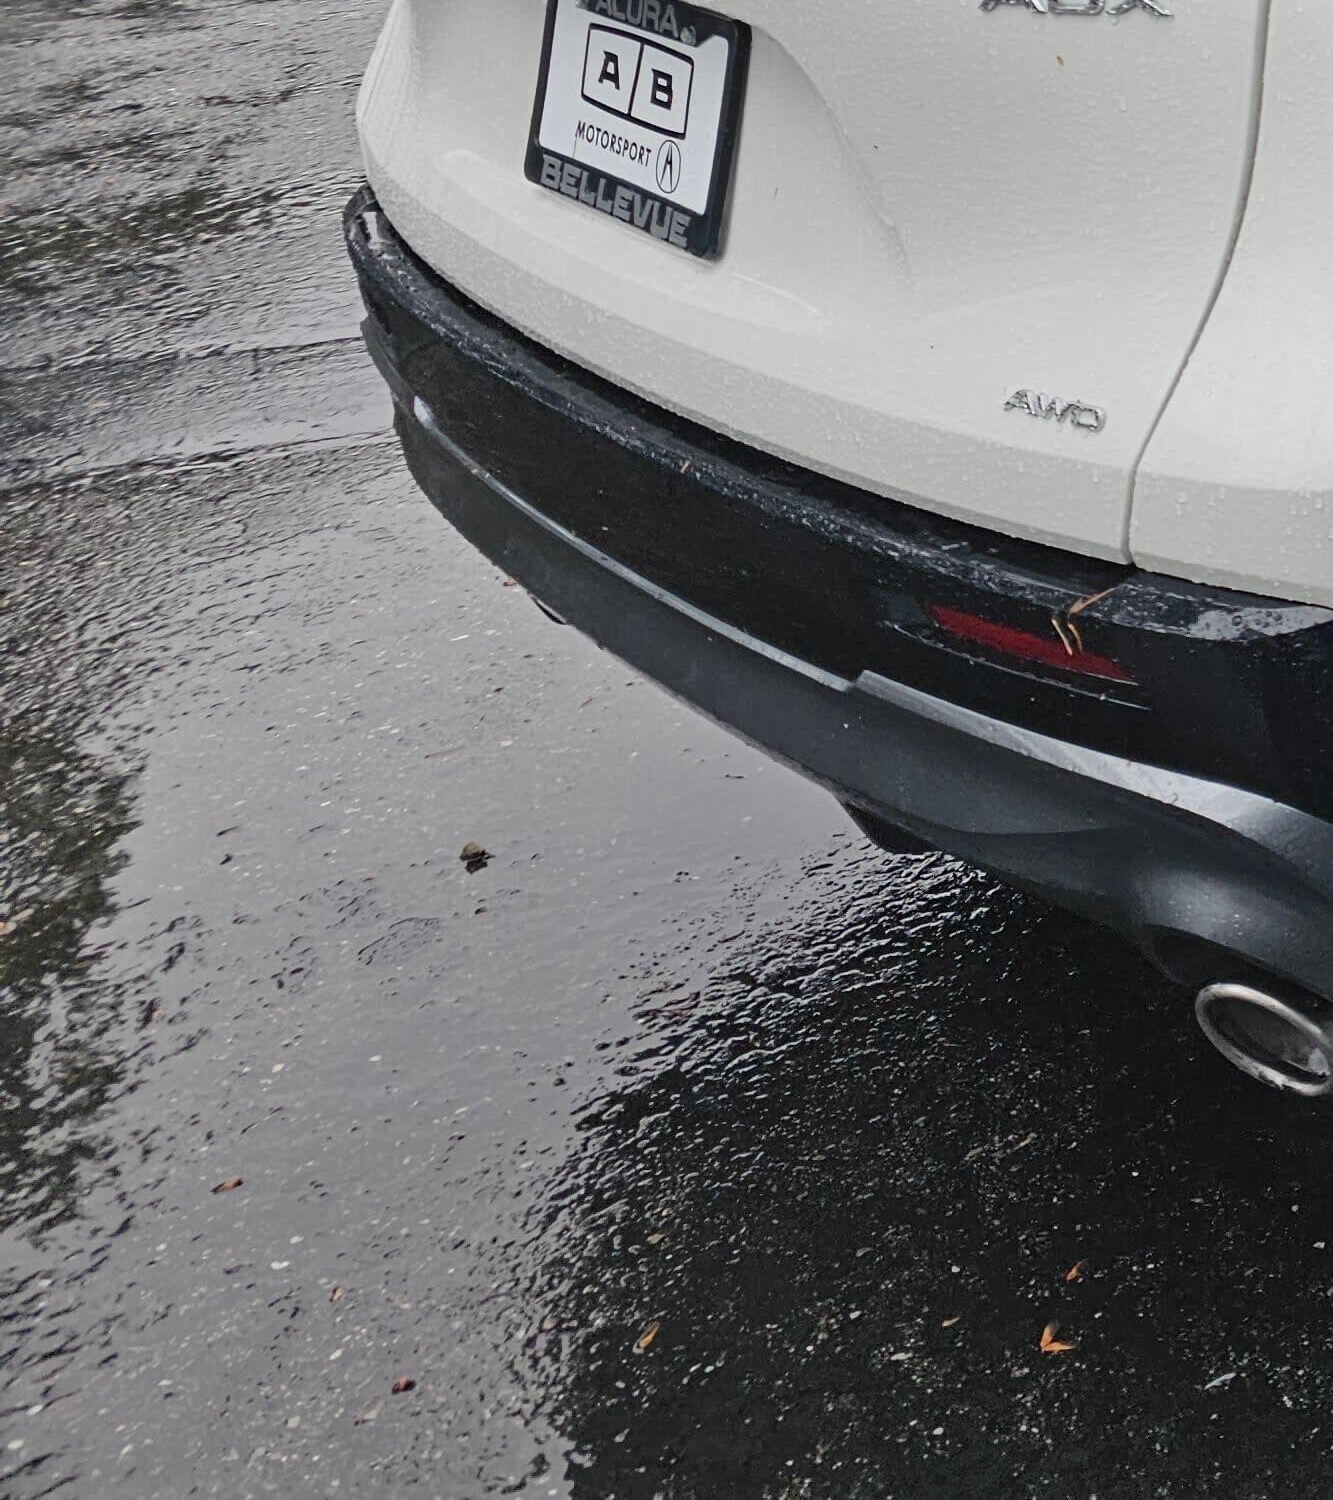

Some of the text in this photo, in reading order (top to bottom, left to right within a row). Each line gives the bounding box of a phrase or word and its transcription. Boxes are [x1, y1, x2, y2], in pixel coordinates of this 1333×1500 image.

[575, 120, 652, 168] MOTORSPORT
[541, 154, 691, 248] BELLEVUE
[1003, 388, 1106, 433] AWD
